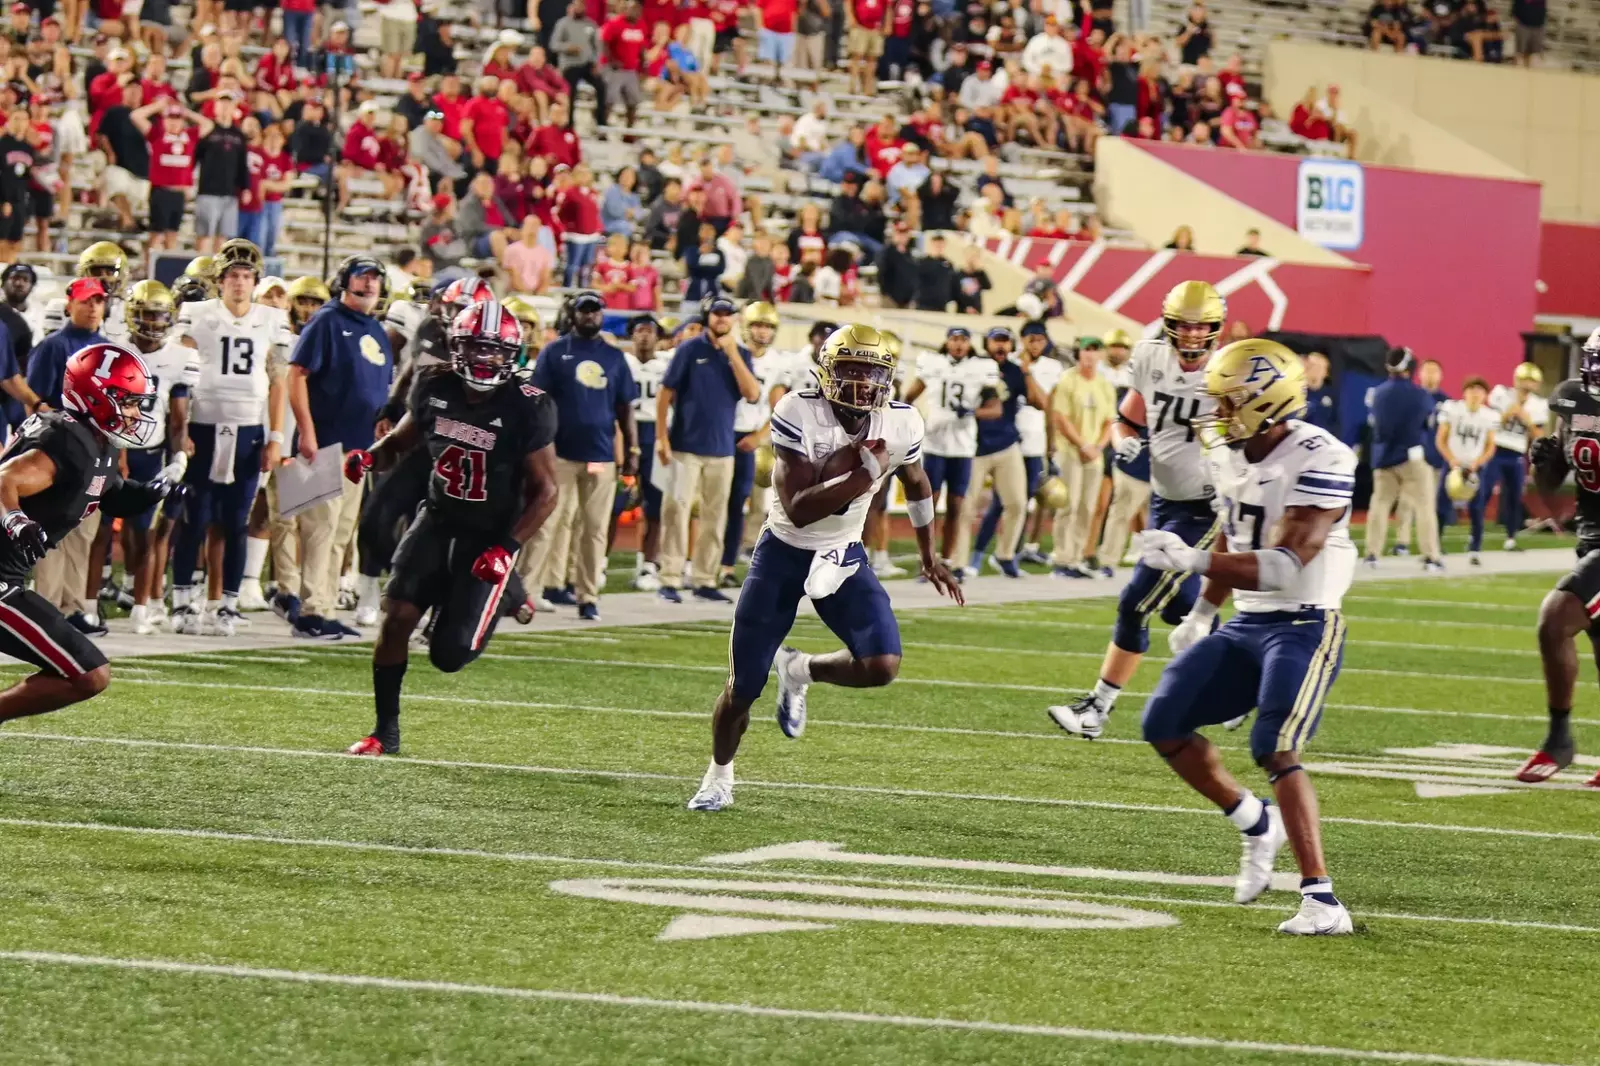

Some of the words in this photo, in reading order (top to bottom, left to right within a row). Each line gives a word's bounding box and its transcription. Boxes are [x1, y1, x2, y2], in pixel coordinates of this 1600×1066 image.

[95, 349, 120, 379] I
[220, 336, 254, 375] 13
[1245, 356, 1285, 383] A
[941, 380, 964, 412] 13
[219, 425, 234, 436] A
[1153, 391, 1199, 442] 74
[434, 416, 496, 451] HOOSIERS
[434, 444, 488, 502] 41
[820, 549, 841, 567] A
